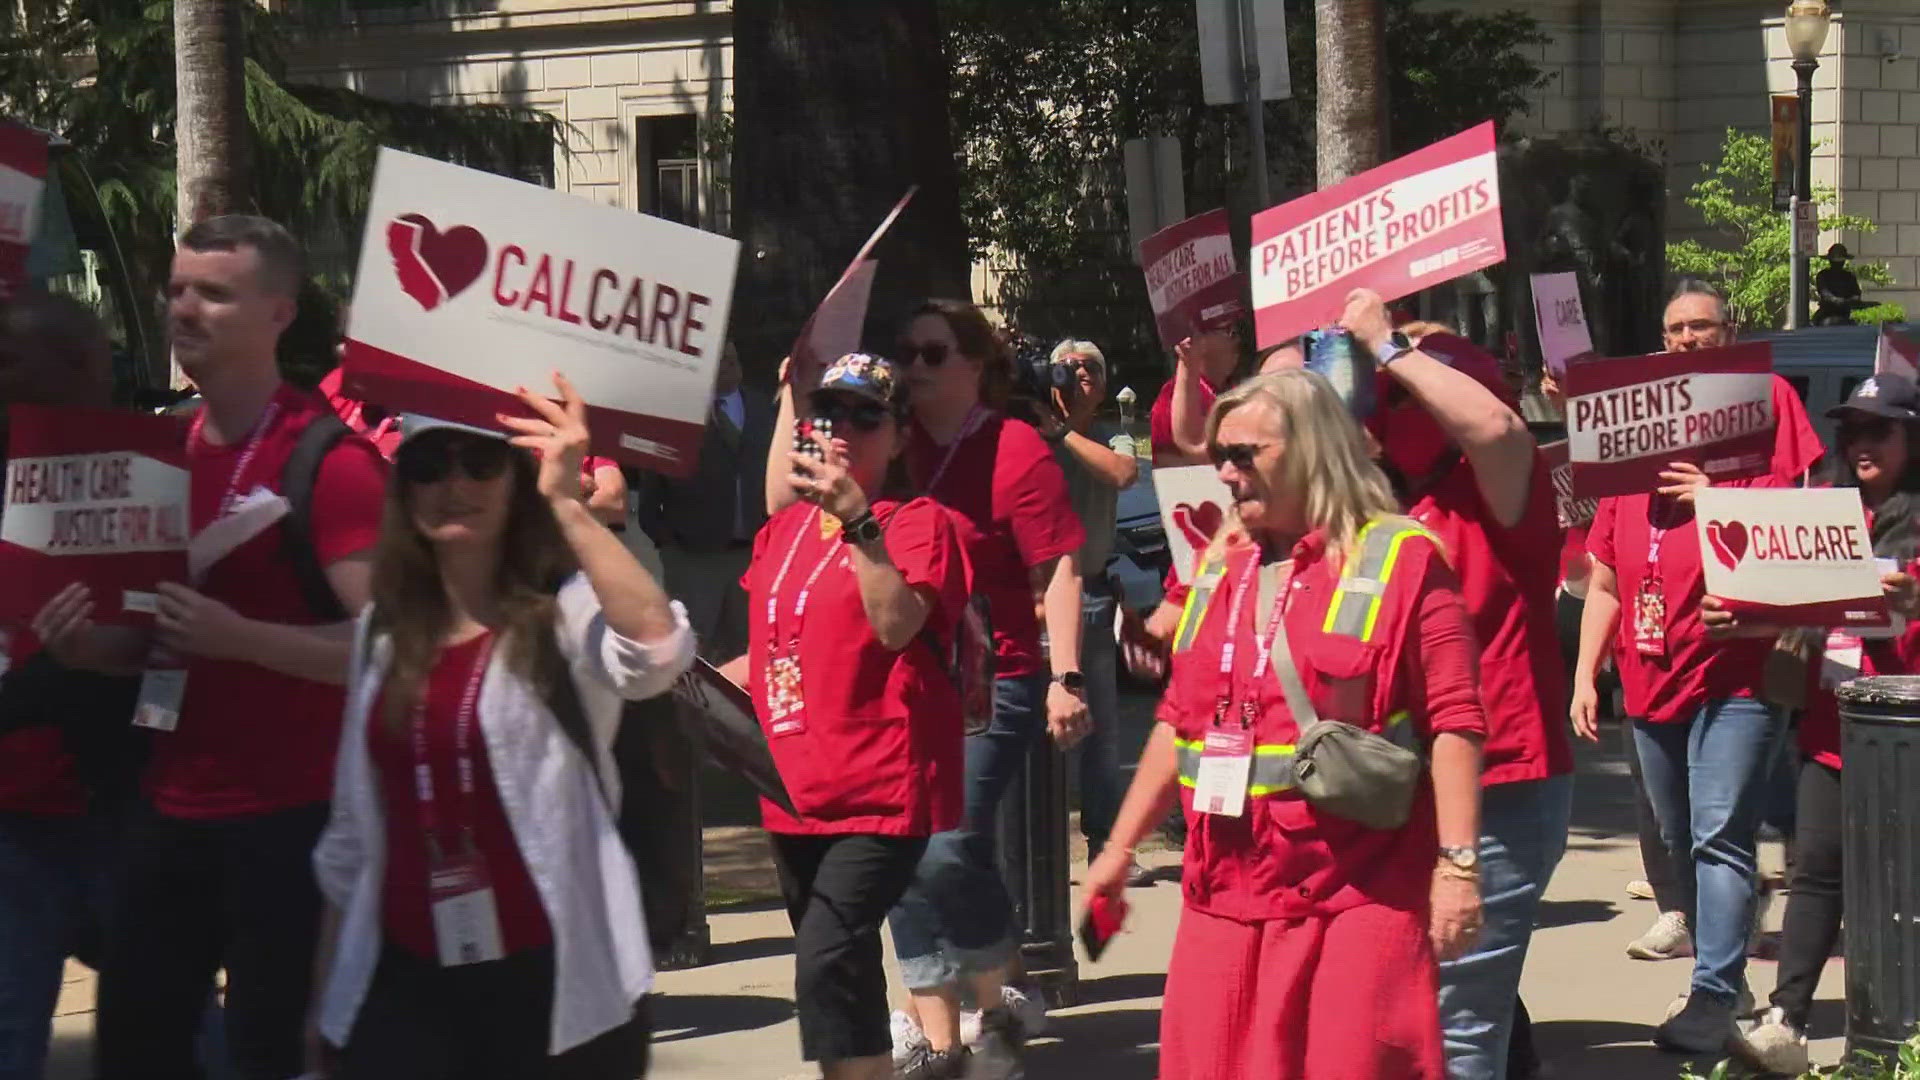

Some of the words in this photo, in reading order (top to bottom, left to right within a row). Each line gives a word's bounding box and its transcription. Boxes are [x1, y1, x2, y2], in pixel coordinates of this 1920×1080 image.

[1262, 188, 1396, 275] PATIENTS
[1286, 238, 1377, 296] BEFORE
[1385, 179, 1491, 250] PROFITS
[1173, 241, 1197, 274] CARE
[1192, 262, 1213, 287] FOR
[1213, 253, 1230, 281] ALL
[493, 244, 712, 358] CALCARE
[1555, 296, 1582, 326] CARE
[1576, 379, 1692, 432] PATIENTS
[1599, 418, 1678, 460] BEFORE
[1685, 400, 1768, 442] PROFITS
[12, 464, 86, 504] HEALTH
[89, 457, 132, 500] CARE
[48, 507, 118, 546] JUSTICE
[119, 504, 151, 544] FOR
[1751, 524, 1863, 562] CALCARE
